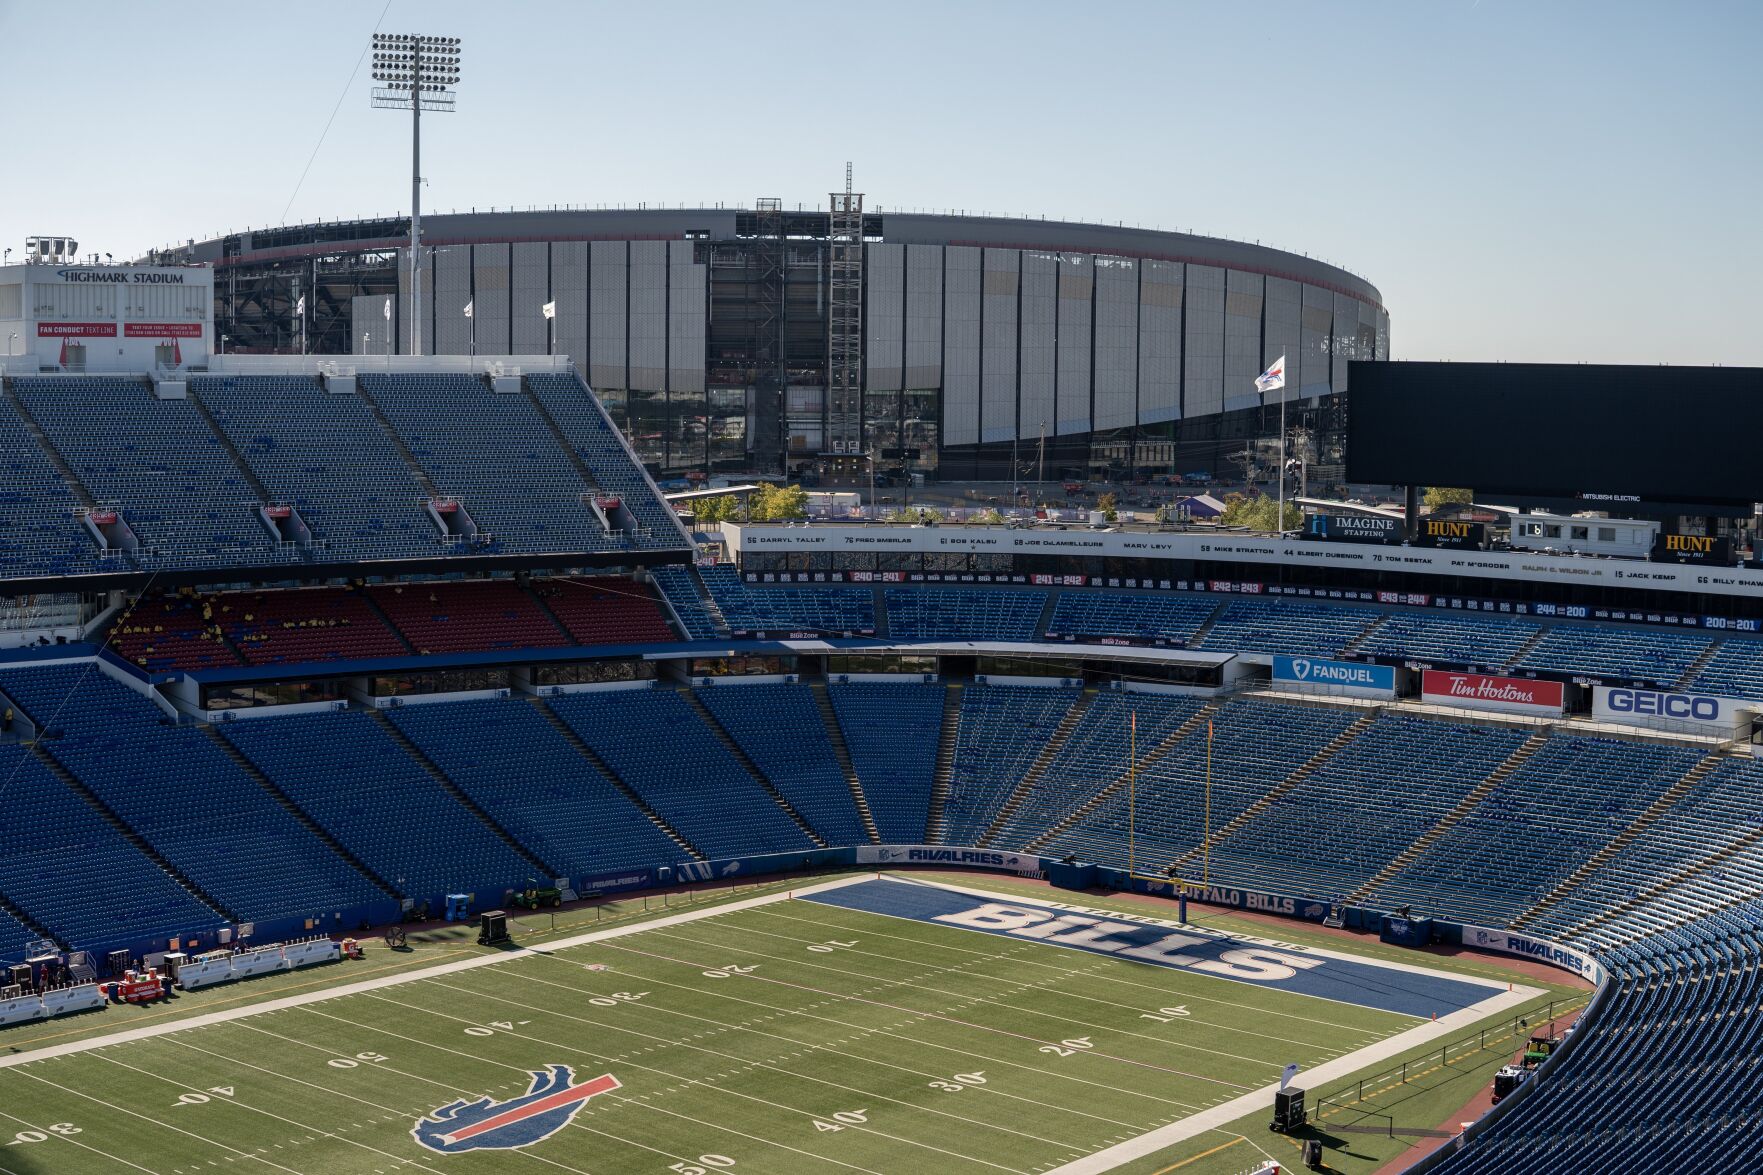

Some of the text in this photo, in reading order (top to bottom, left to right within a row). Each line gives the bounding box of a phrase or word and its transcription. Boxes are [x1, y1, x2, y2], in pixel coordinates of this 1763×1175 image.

[65, 272, 184, 284] HIGHMARK STADIUM
[40, 326, 114, 335] FAN CONDUCT TEXT LINE
[1336, 518, 1394, 530] IMAGINE
[1427, 521, 1470, 537] HUNT
[1666, 535, 1714, 552] HUNT
[854, 572, 872, 581] 240
[882, 572, 900, 581] 241
[1036, 575, 1053, 584] 241
[1064, 576, 1082, 585] 242
[1214, 582, 1231, 592] 242
[1241, 583, 1258, 593] 243
[1381, 592, 1398, 602] 243
[1408, 594, 1425, 604] 244
[1537, 604, 1555, 615] 244
[1566, 606, 1585, 617] 200
[1706, 617, 1726, 628] 200
[1736, 620, 1755, 631] 201
[1313, 666, 1374, 682] FANDUEL
[1450, 676, 1533, 702] Tim Hortons
[1608, 689, 1719, 720] GEICO
[908, 849, 1004, 865] RIVALRIES
[592, 876, 639, 888] RIVALRIES
[1173, 882, 1295, 914] BUFFALO BILLS
[1085, 909, 1163, 924] TAKES
[1272, 942, 1309, 951] US
[807, 940, 854, 953] 10
[932, 902, 1326, 980] BILLS
[1507, 937, 1583, 972] RIVALRIES
[702, 965, 756, 978] 20
[588, 992, 642, 1006] 30
[1140, 1007, 1191, 1023] 10
[464, 1021, 514, 1036] 40
[1039, 1039, 1093, 1057] 20
[327, 1052, 389, 1068] 50
[928, 1072, 987, 1092] 30
[179, 1086, 235, 1104] 40
[812, 1111, 868, 1132] 40
[15, 1122, 83, 1143] 30
[668, 1154, 736, 1175] 50
